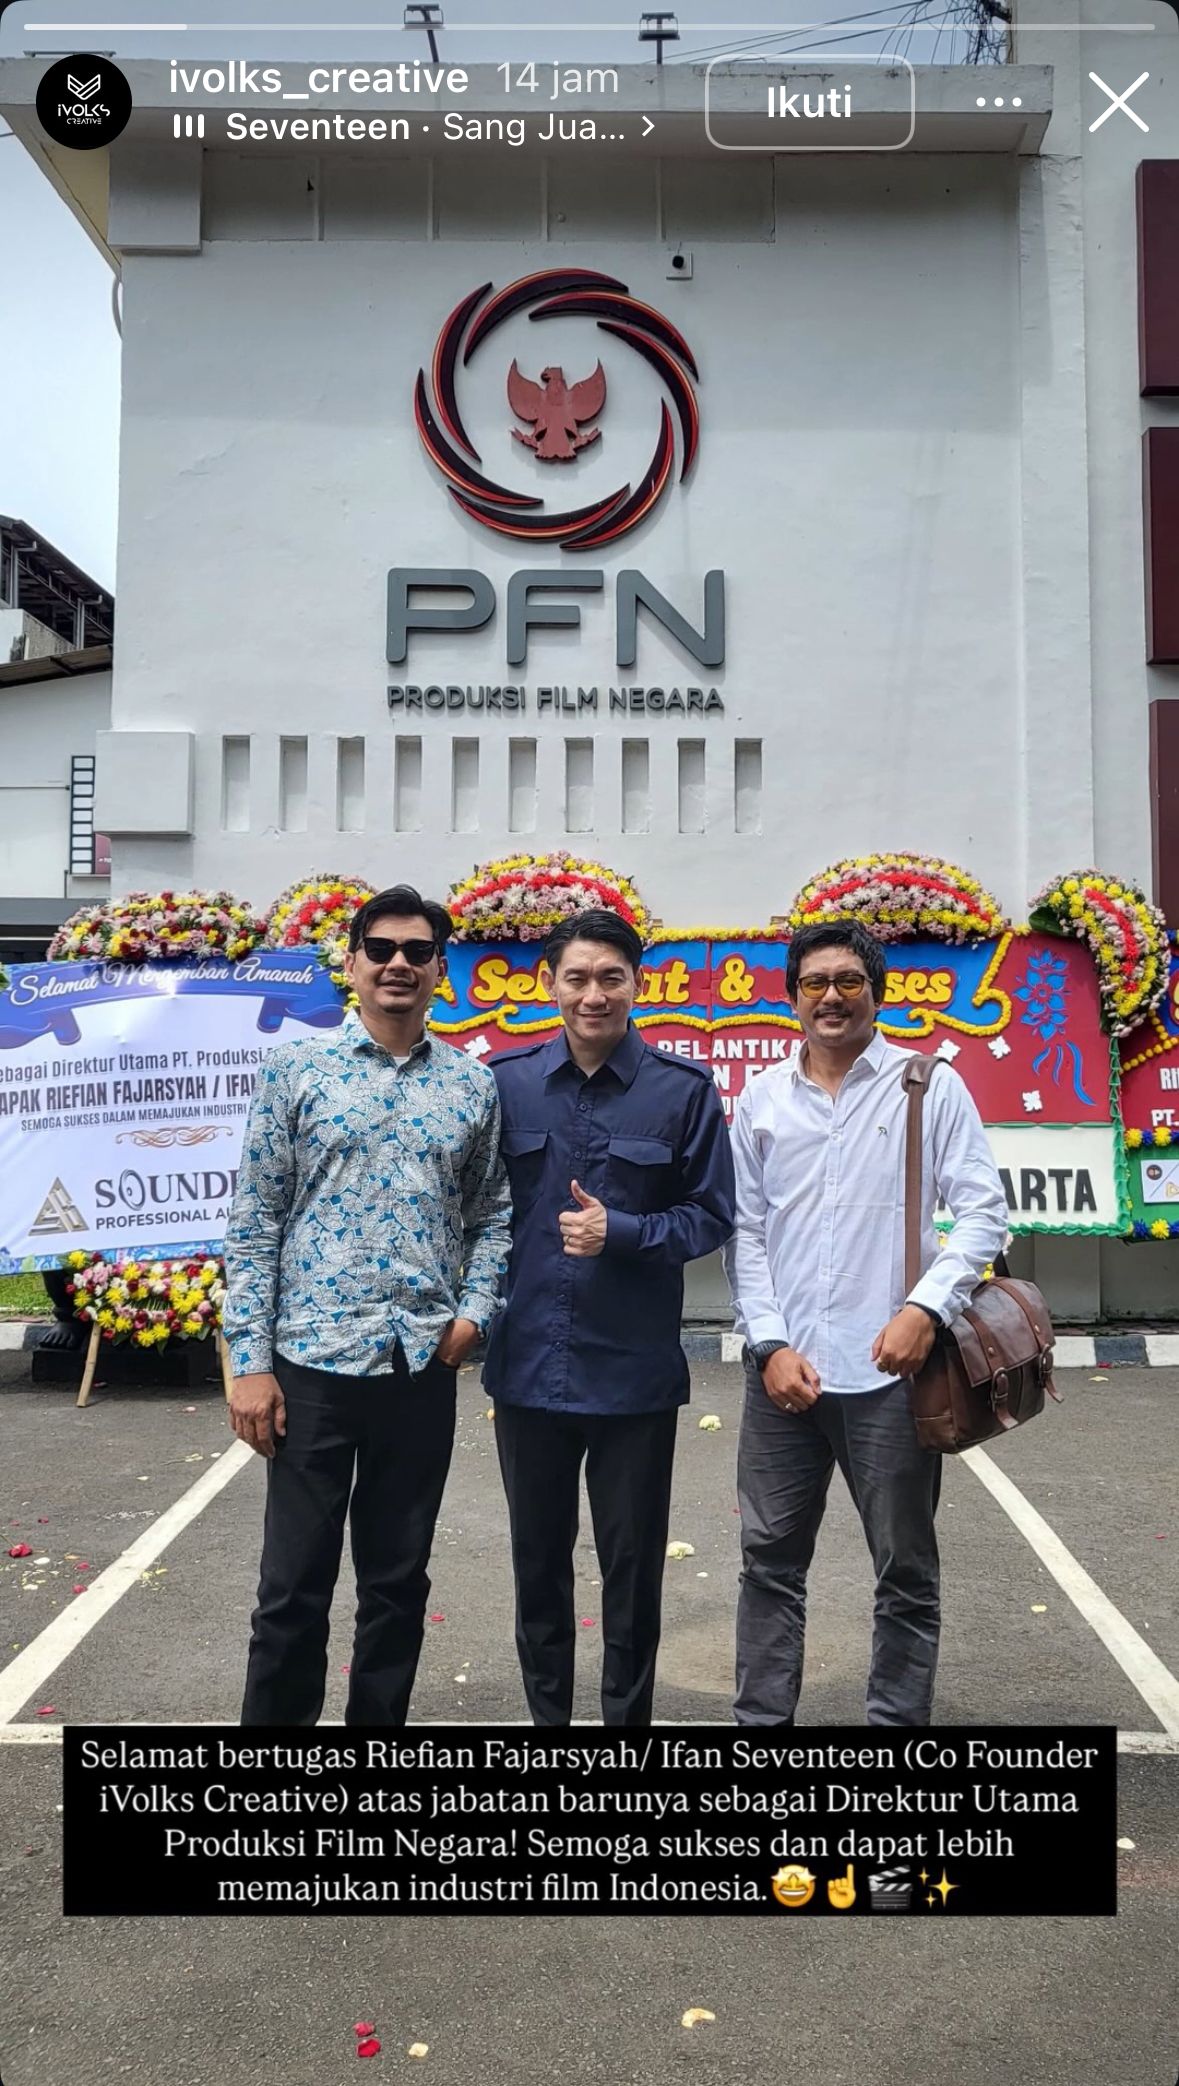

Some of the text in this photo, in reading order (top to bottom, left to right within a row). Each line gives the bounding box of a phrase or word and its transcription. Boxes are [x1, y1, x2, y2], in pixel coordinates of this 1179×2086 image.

[385, 567, 726, 667] PFN
[386, 685, 725, 712] PRODUKSI FILM NEGARA
[10, 970, 98, 1006] Selamat
[232, 956, 314, 985] Amanah
[473, 958, 690, 1003] Selat
[719, 958, 755, 1003] &
[52, 1057, 116, 1078] Direktur
[119, 1053, 168, 1071] Utama
[172, 1051, 192, 1068] PT.
[196, 1047, 263, 1066] Produksi
[46, 1082, 108, 1111] RIEFIAN
[113, 1075, 207, 1104] FAJARSYAH
[212, 1074, 220, 1098] /
[21, 1103, 247, 1131] SEMOGA SUKSES DALAM MEMAJUKAN INDUSTRI
[96, 1208, 211, 1230] PROFESSIONAL
